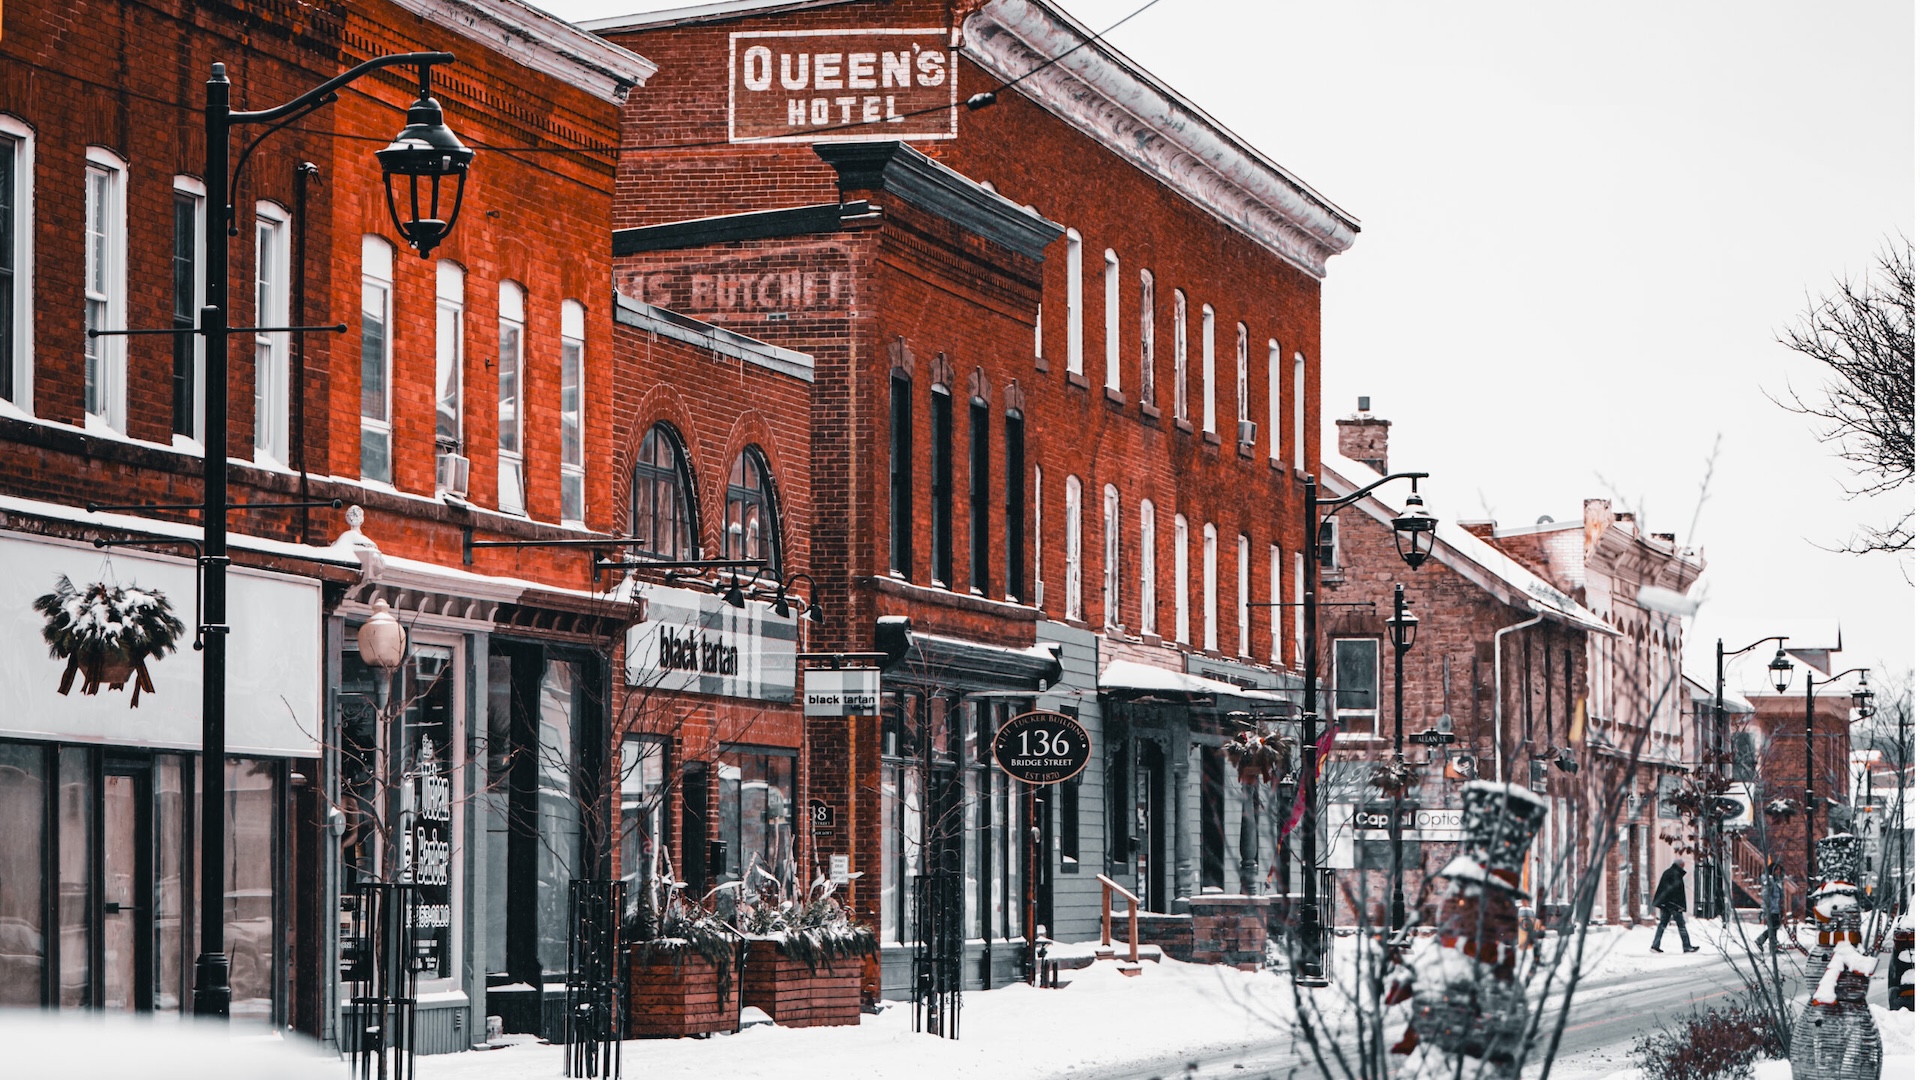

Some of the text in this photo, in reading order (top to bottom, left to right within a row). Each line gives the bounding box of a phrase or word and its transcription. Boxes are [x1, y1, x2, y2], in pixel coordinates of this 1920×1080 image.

[744, 42, 946, 91] QUEEN'S
[788, 96, 904, 126] HOTEL
[660, 625, 738, 676] black tartan
[809, 695, 875, 704] black tartan
[1017, 729, 1070, 756] 136
[1417, 735, 1438, 743] ALLAN
[1011, 758, 1073, 766] BRIDGE STREET
[422, 762, 450, 821] Urban
[1355, 811, 1412, 828] Capal
[417, 826, 449, 885] Barber
